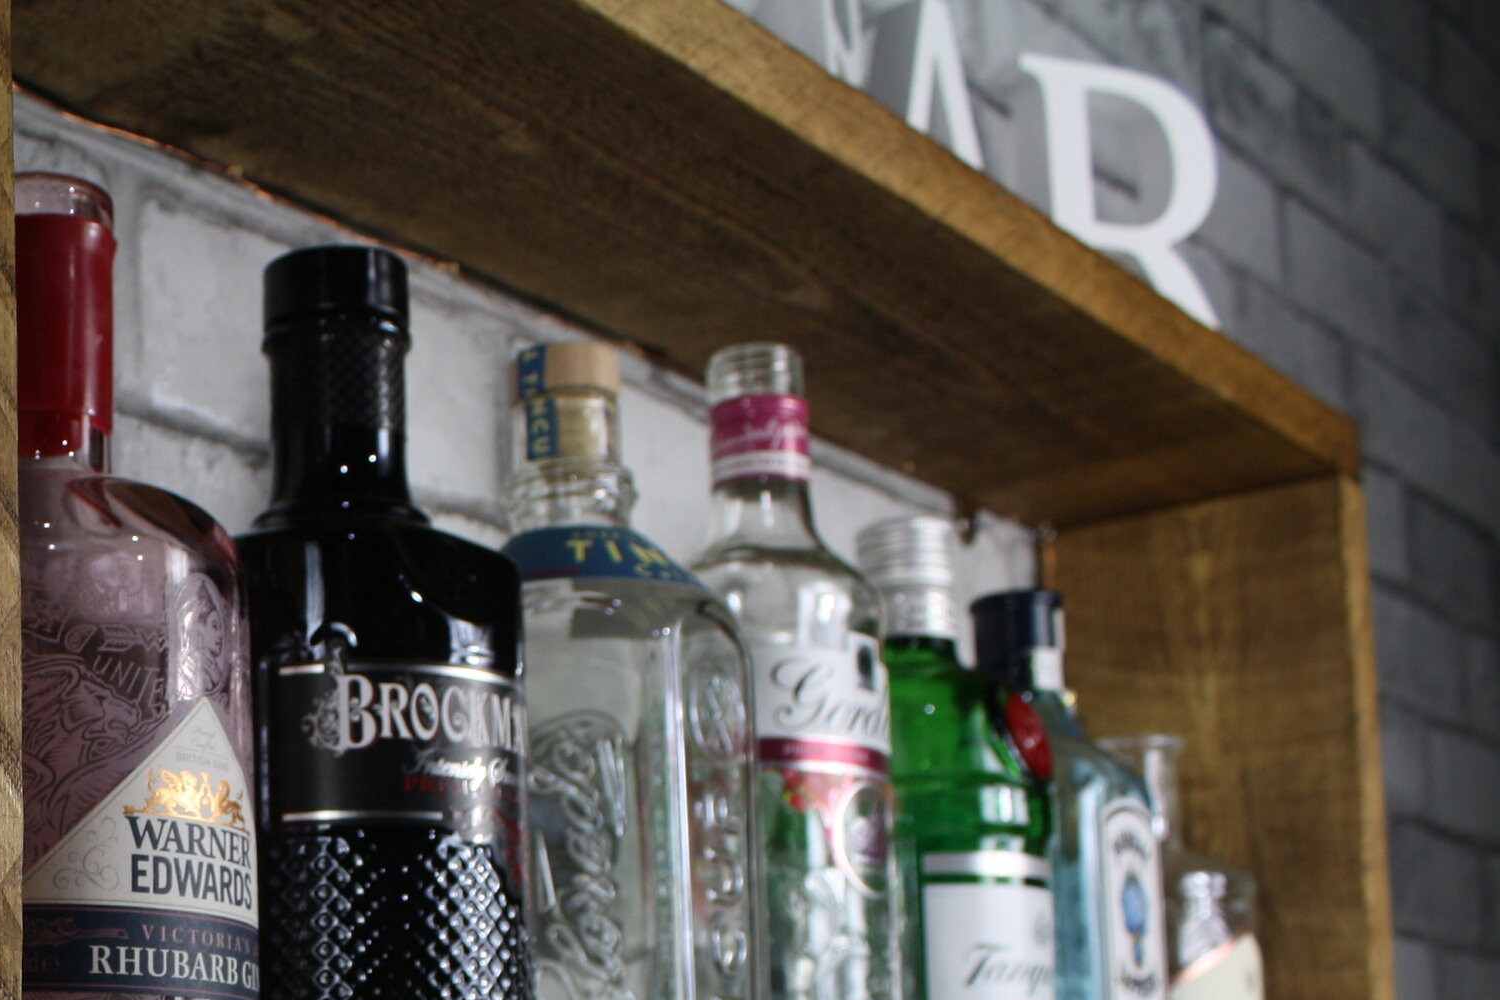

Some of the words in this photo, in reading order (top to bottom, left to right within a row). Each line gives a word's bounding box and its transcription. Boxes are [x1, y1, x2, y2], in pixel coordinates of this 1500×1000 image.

[125, 816, 251, 869] WARNER
[131, 854, 252, 910] EDWARDS
[141, 924, 251, 954] VICTORIA'S
[88, 945, 238, 985] RHUBARB
